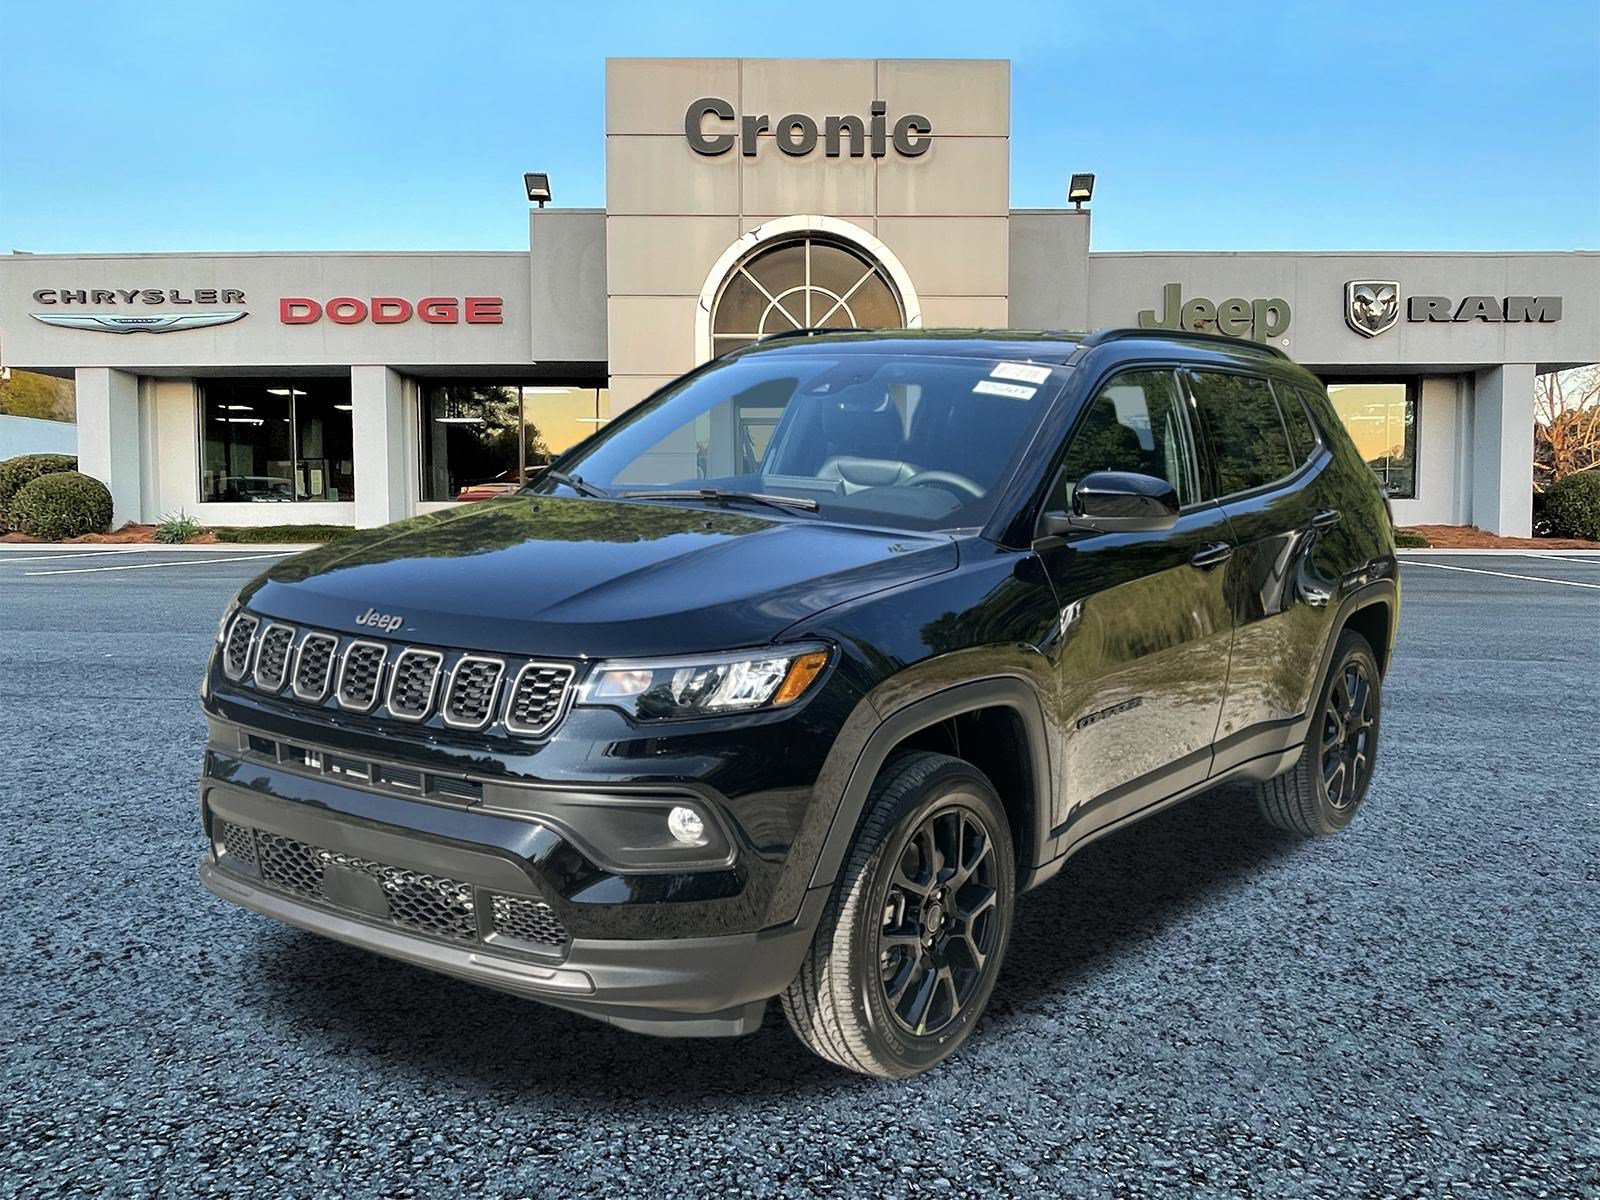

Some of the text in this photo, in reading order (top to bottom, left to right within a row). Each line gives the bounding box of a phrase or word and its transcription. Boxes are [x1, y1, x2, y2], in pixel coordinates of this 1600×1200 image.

[685, 97, 932, 157] Cronic
[32, 288, 247, 305] CHRYSLER
[1407, 296, 1563, 322] RAM
[279, 297, 503, 324] DODGE
[1138, 283, 1291, 345] Jeep
[355, 608, 404, 633] Jeep
